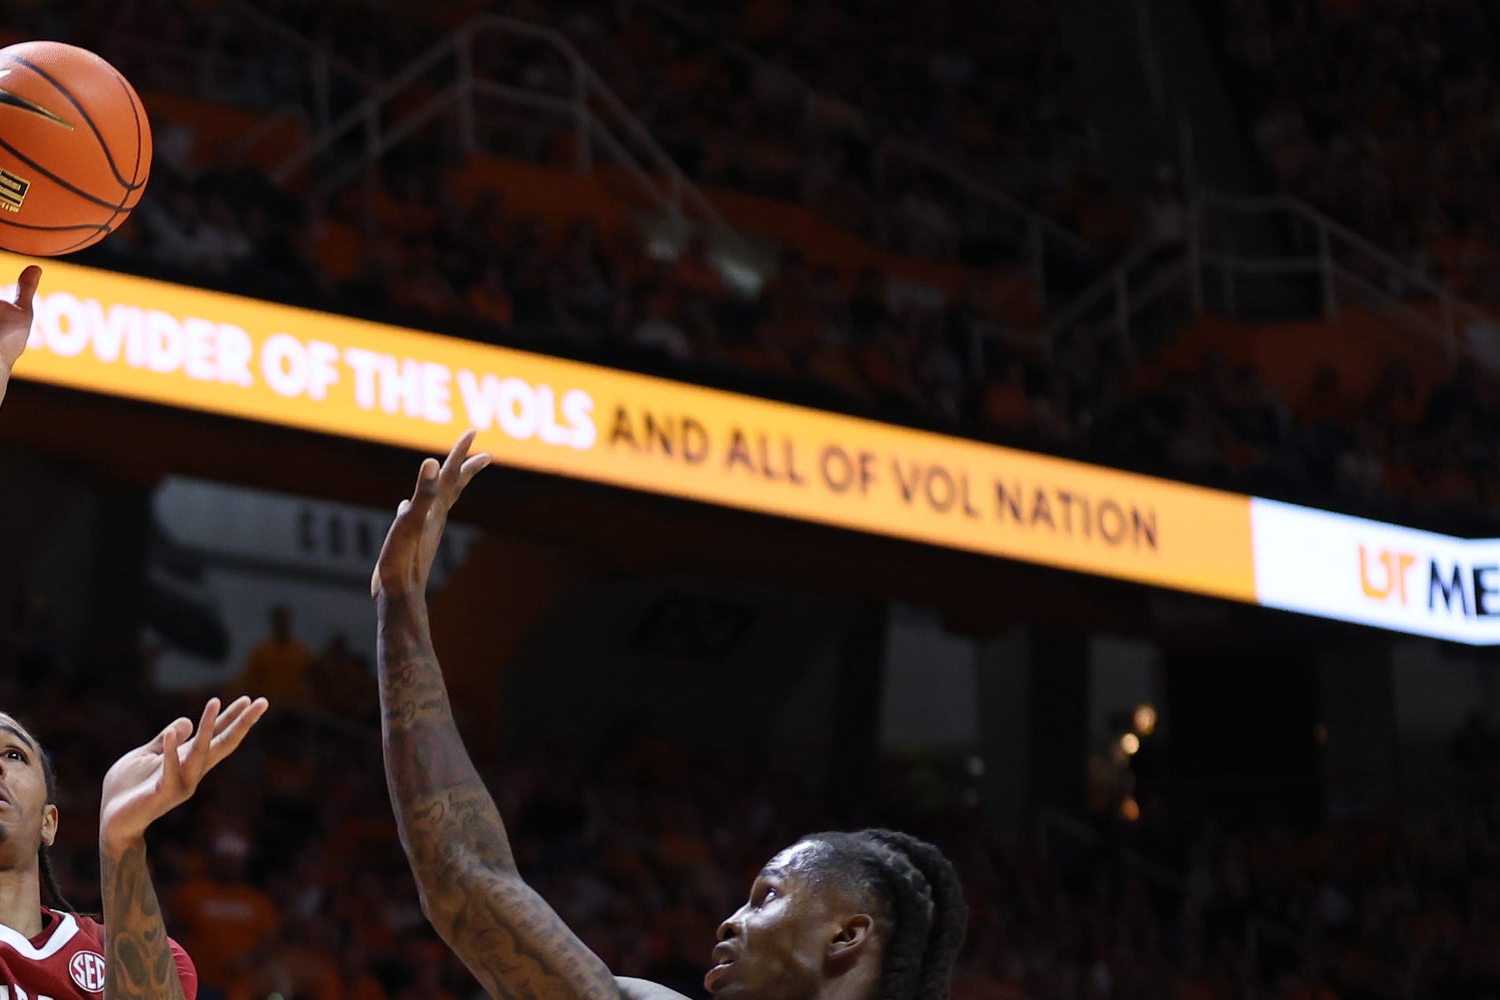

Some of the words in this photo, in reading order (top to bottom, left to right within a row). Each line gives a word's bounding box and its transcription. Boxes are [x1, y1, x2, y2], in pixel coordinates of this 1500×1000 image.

[260, 333, 340, 401] OF
[344, 347, 453, 424] THE
[457, 369, 597, 451] VOLS
[609, 405, 710, 464] AND
[725, 427, 804, 485] ALL
[819, 444, 876, 495] OF
[891, 459, 980, 519] VOL
[994, 482, 1158, 549] NATION
[1358, 545, 1416, 605] UT
